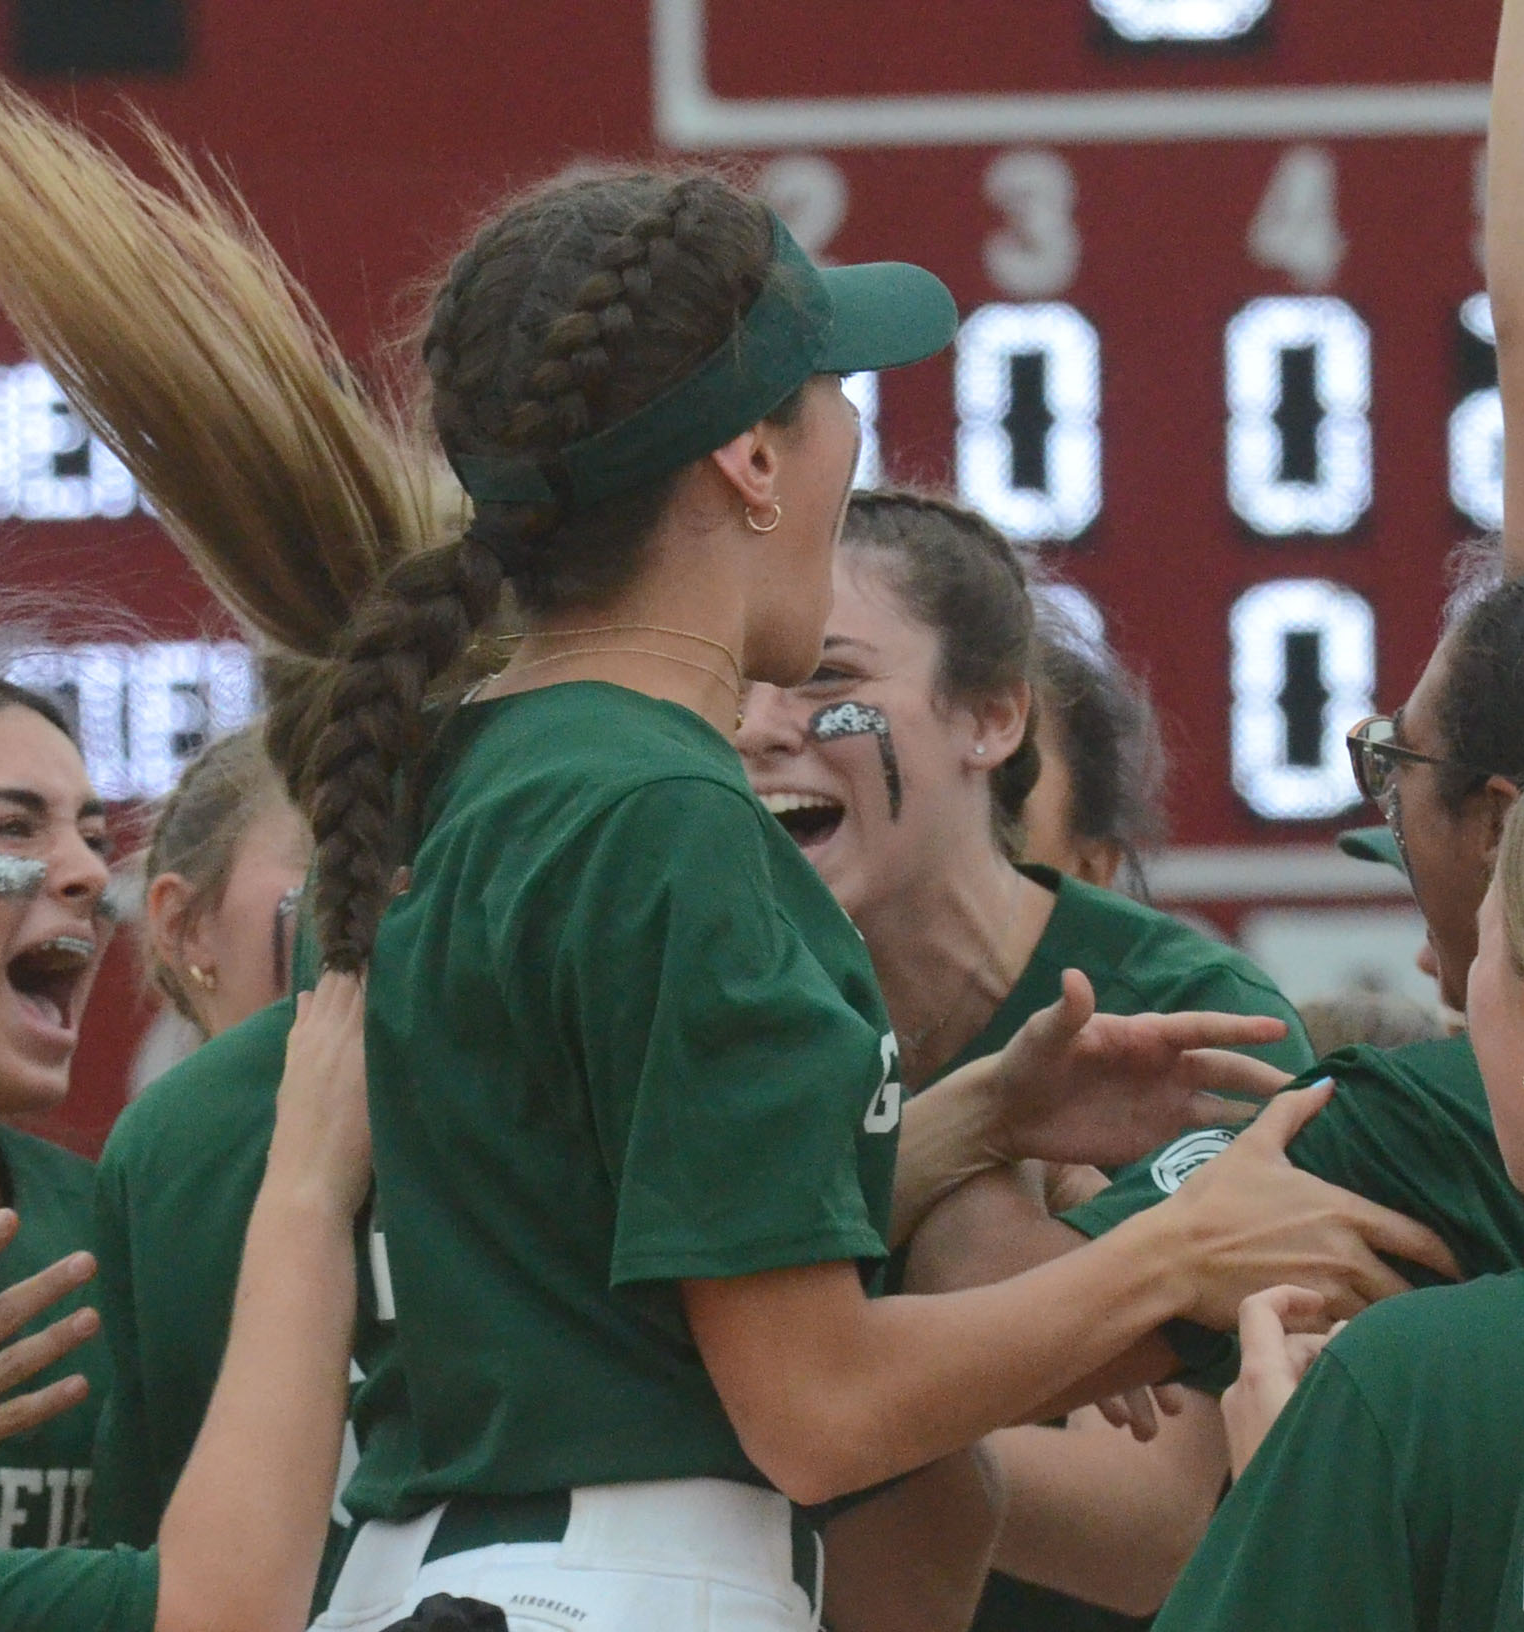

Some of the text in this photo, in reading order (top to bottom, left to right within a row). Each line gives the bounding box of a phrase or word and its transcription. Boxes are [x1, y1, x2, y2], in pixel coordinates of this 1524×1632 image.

[983, 148, 1075, 296] 3
[1247, 146, 1345, 290] 4
[954, 303, 1100, 540] 0
[1225, 296, 1371, 536] 0
[1229, 580, 1375, 819] 0
